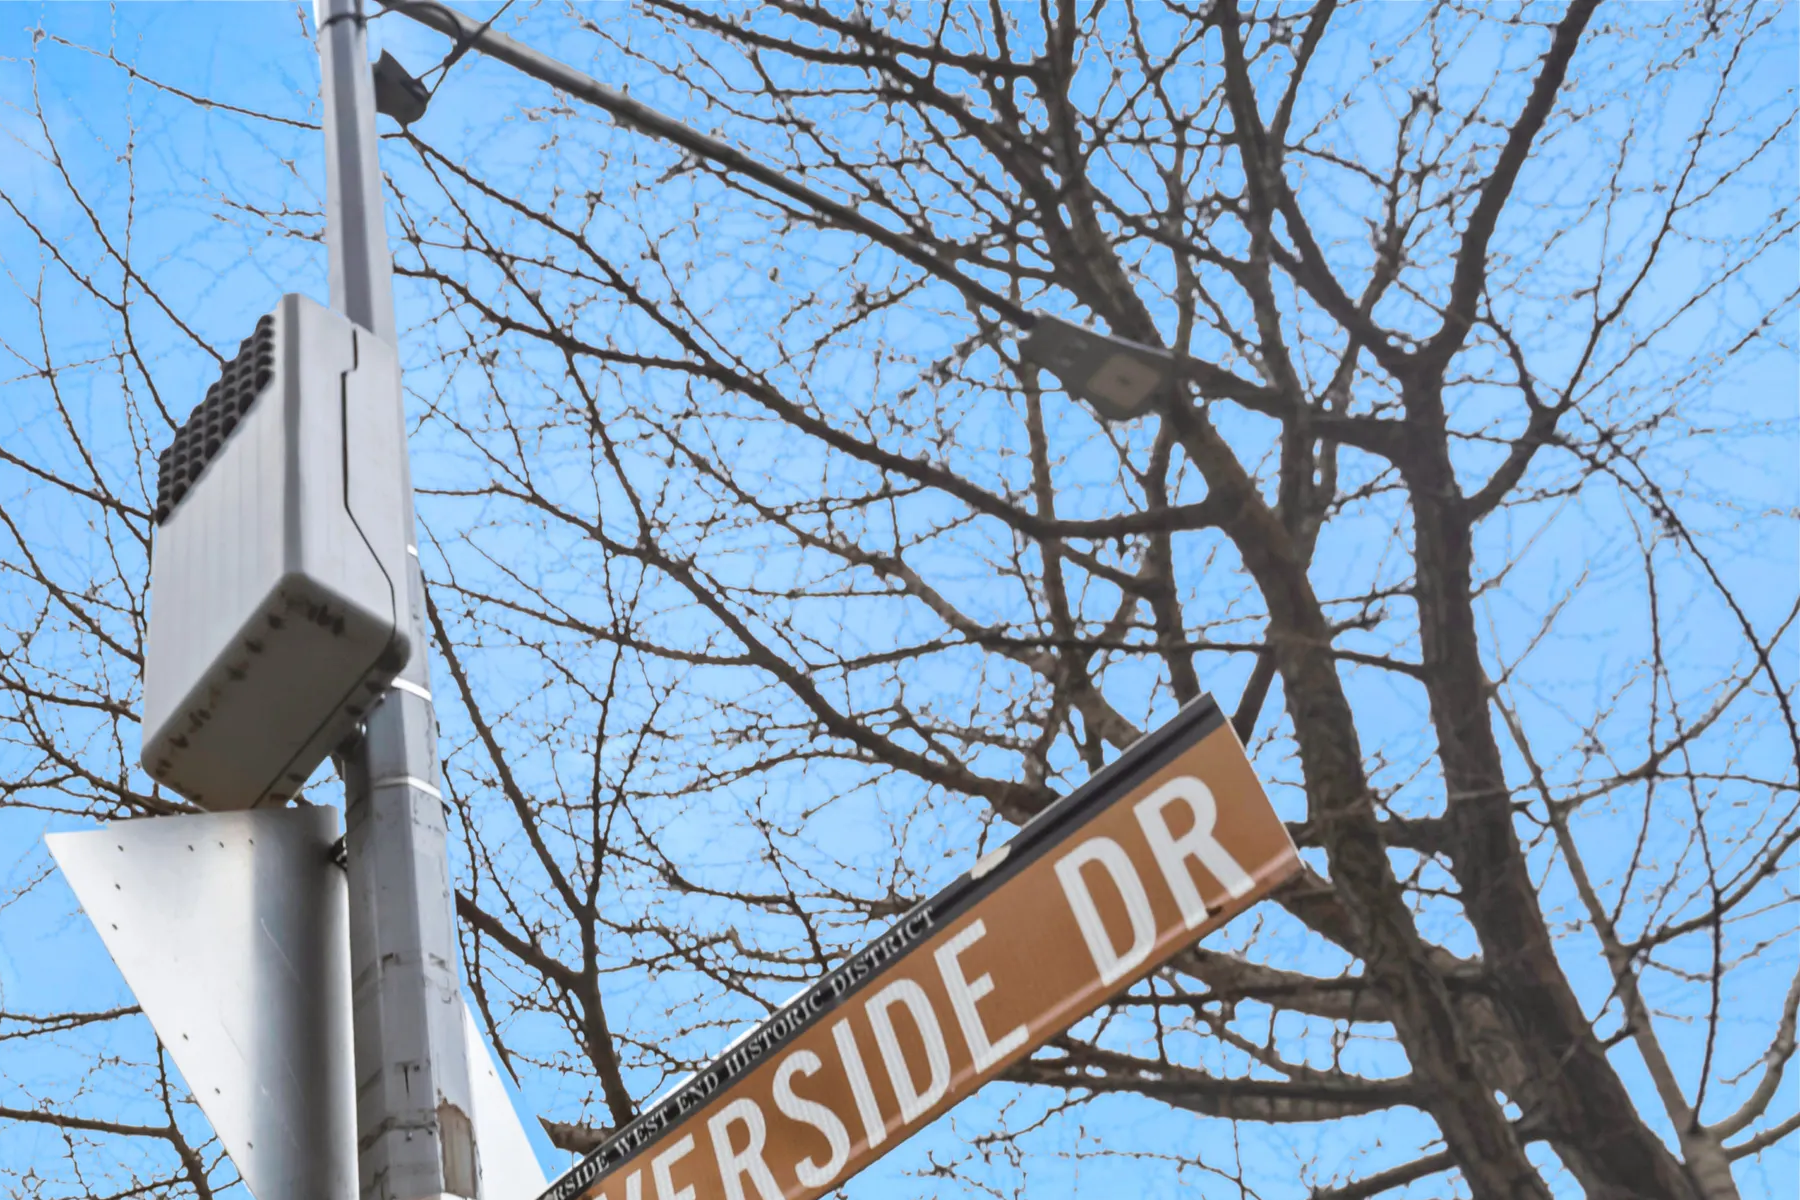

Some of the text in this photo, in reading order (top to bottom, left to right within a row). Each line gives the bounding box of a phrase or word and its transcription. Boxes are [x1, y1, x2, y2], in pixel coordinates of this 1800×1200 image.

[1054, 774, 1255, 988] DR
[613, 1107, 669, 1157] WEST
[676, 1070, 720, 1115] END
[724, 991, 823, 1079] HISTORIC
[830, 906, 935, 998] DISTRICT
